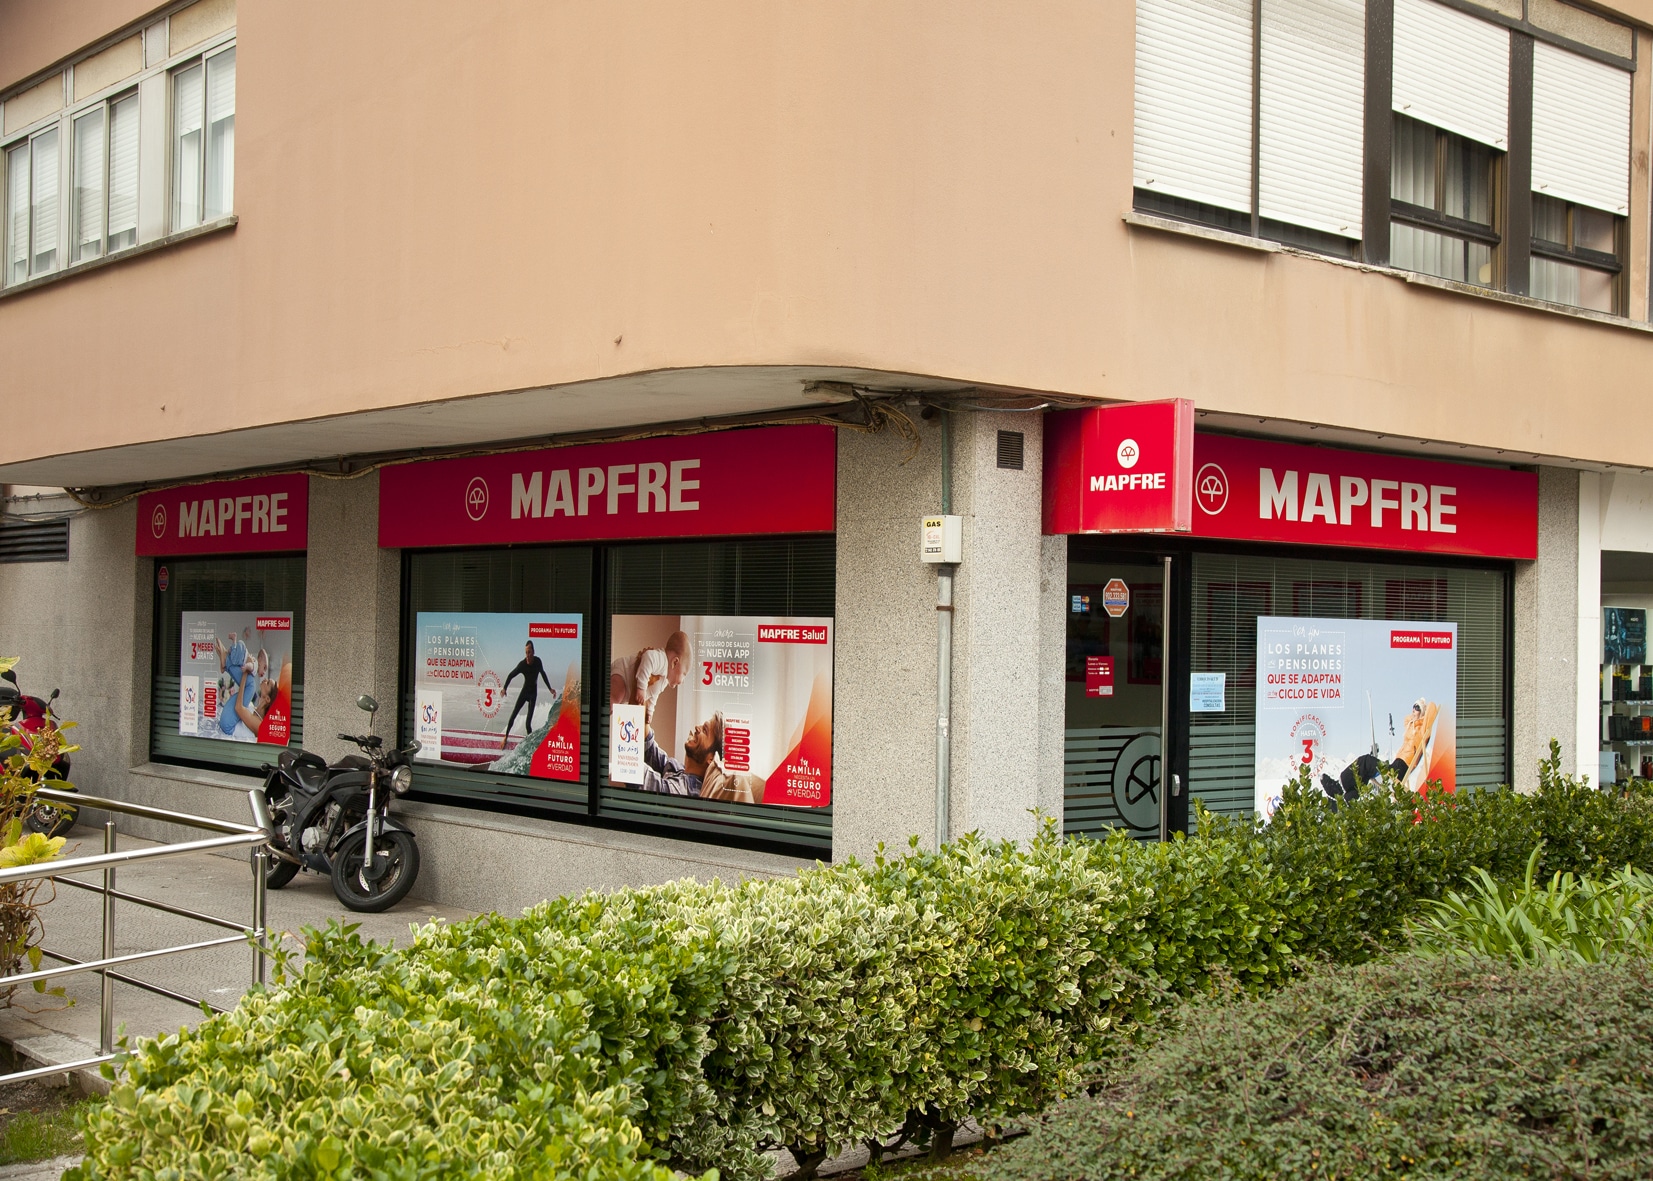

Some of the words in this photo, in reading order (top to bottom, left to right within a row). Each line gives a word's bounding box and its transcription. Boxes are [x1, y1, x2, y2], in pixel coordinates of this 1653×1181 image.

[1090, 472, 1166, 492] MAPFRE
[511, 458, 701, 519] MAPFRE
[1259, 467, 1457, 534] MAPFRE
[178, 492, 288, 538] MAPFRE
[257, 619, 277, 628] MAPFRE
[278, 619, 290, 628] Salud
[427, 635, 442, 644] LOS
[445, 636, 475, 645] PLANES
[760, 628, 800, 640] MAPFRE
[802, 629, 825, 641] Salud
[1393, 635, 1421, 643] PROGRAMA
[1423, 636, 1431, 644] TU
[705, 640, 725, 648] SEGURO
[733, 641, 750, 650] SALUD
[1268, 643, 1291, 655] LOS
[1296, 643, 1342, 655] PLANES
[191, 643, 197, 660] 3
[197, 643, 214, 652] MESES
[197, 652, 214, 660] GRATIS
[433, 647, 475, 657] PENSIONES
[706, 648, 733, 658] NUEVA
[734, 649, 750, 659] APP
[427, 658, 439, 667] QUE
[439, 658, 447, 667] SE
[447, 659, 475, 668] ADAPTAN
[1278, 658, 1342, 670] PENSIONES
[433, 669, 451, 678] CICLO
[451, 670, 460, 679] DE
[460, 671, 474, 679] VIDA
[702, 661, 714, 687] 3
[715, 661, 749, 676] MESES
[1267, 673, 1287, 685] QUE
[1288, 673, 1299, 684] SE
[1300, 673, 1342, 684] ADAPTAN
[714, 674, 750, 688] GRATIS
[1278, 688, 1305, 699] CICLO
[1306, 688, 1319, 699] DE
[1320, 688, 1341, 699] VIDA
[269, 714, 286, 722] FAMILIA
[547, 740, 574, 750] FAMILIA
[547, 754, 574, 764] FUTURO
[551, 763, 574, 773] VERDAD
[787, 764, 821, 776] FAMILIA
[787, 779, 821, 791] SEGURO
[793, 788, 821, 800] VERDAD
